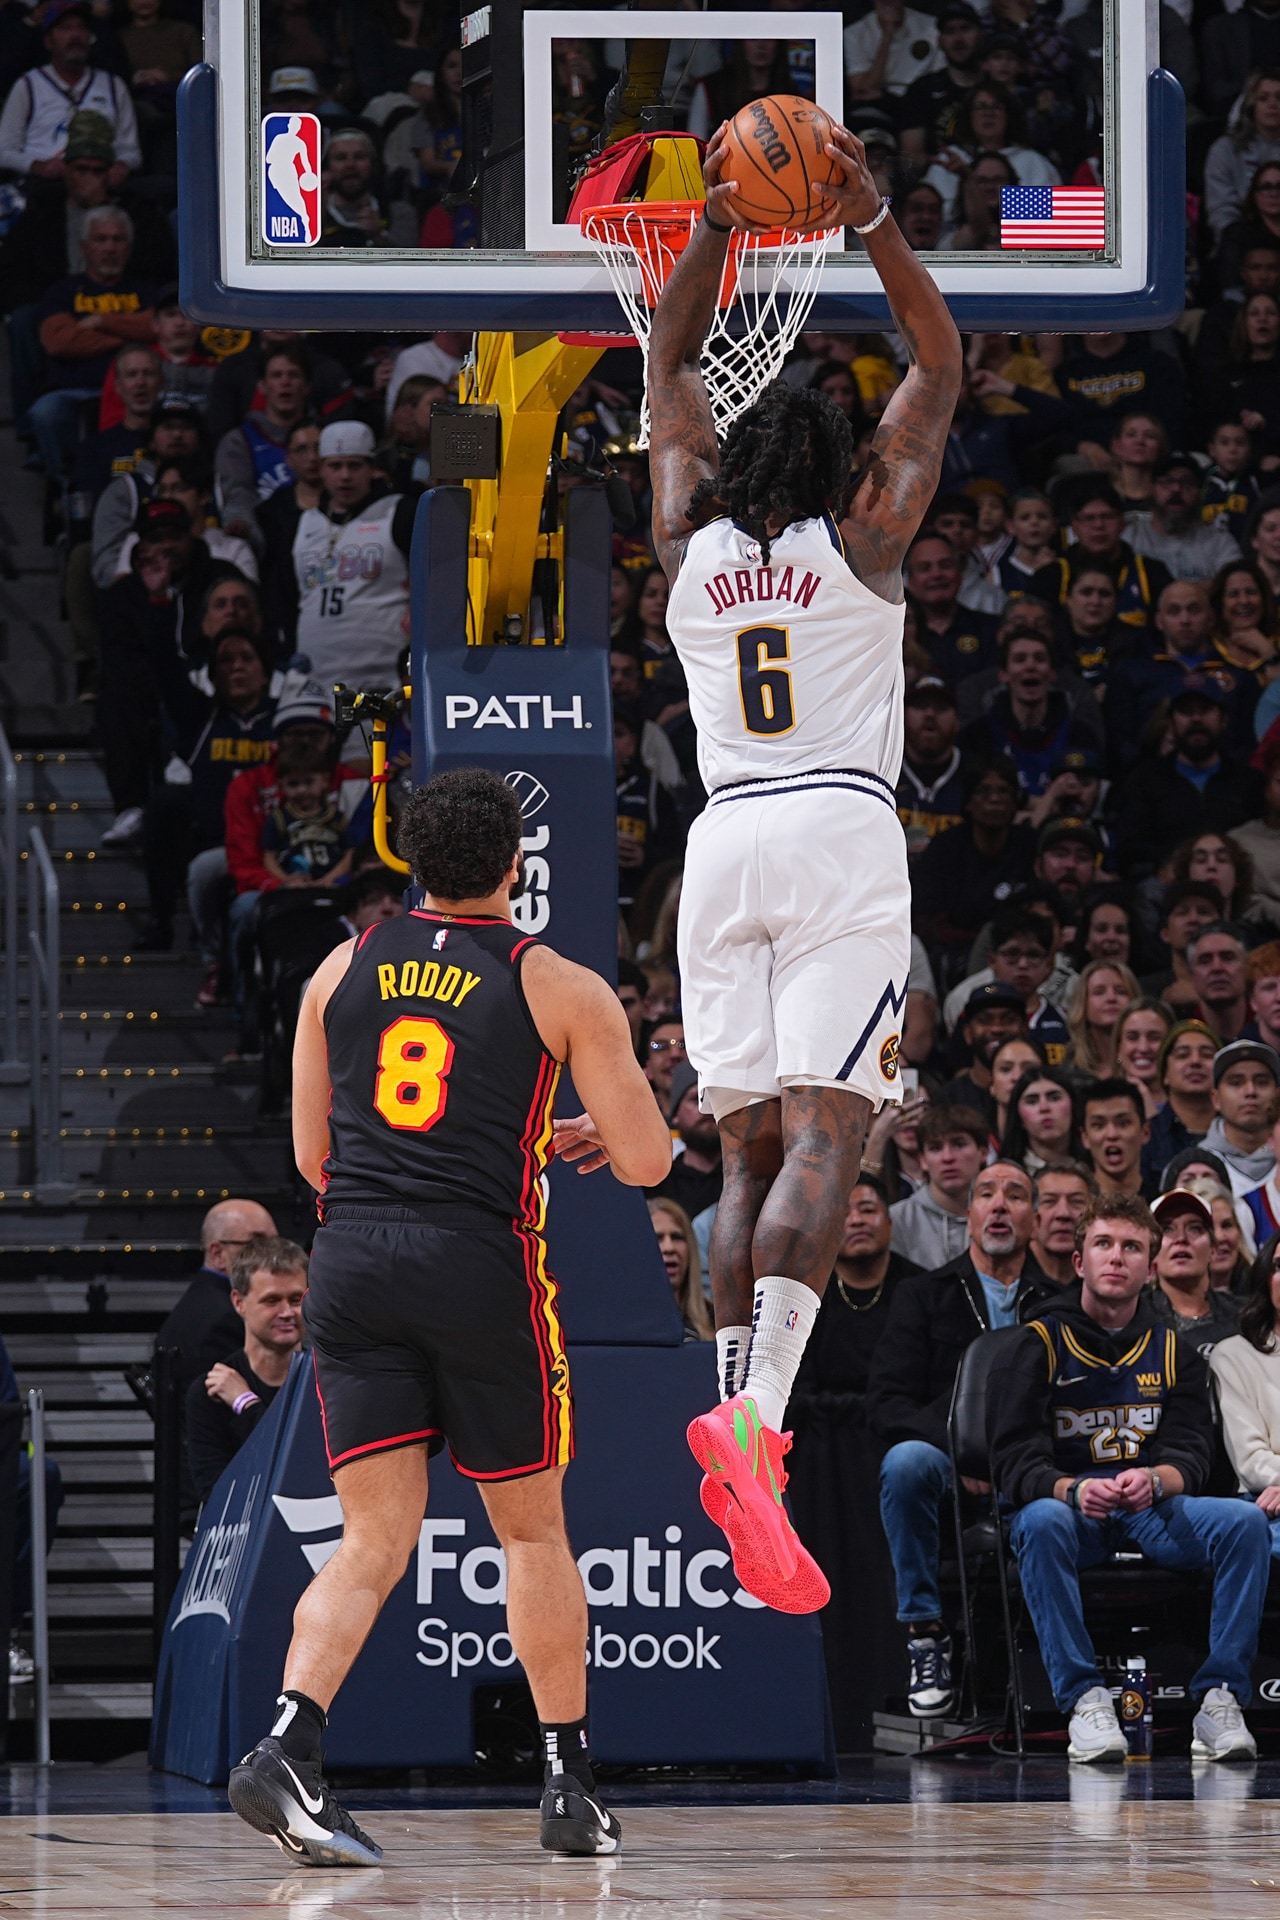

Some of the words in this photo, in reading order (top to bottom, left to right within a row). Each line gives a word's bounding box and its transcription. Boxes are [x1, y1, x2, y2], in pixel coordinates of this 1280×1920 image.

[749, 100, 792, 175] Wilson
[271, 216, 299, 238] NBA
[320, 587, 344, 617] 15
[703, 566, 822, 616] JORDAN
[735, 624, 797, 737] 6
[377, 960, 482, 1008] RODDY
[373, 1015, 456, 1132] 8
[1136, 1372, 1161, 1386] WU
[416, 1518, 771, 1610] Faatic
[415, 1617, 722, 1678] Spobook
